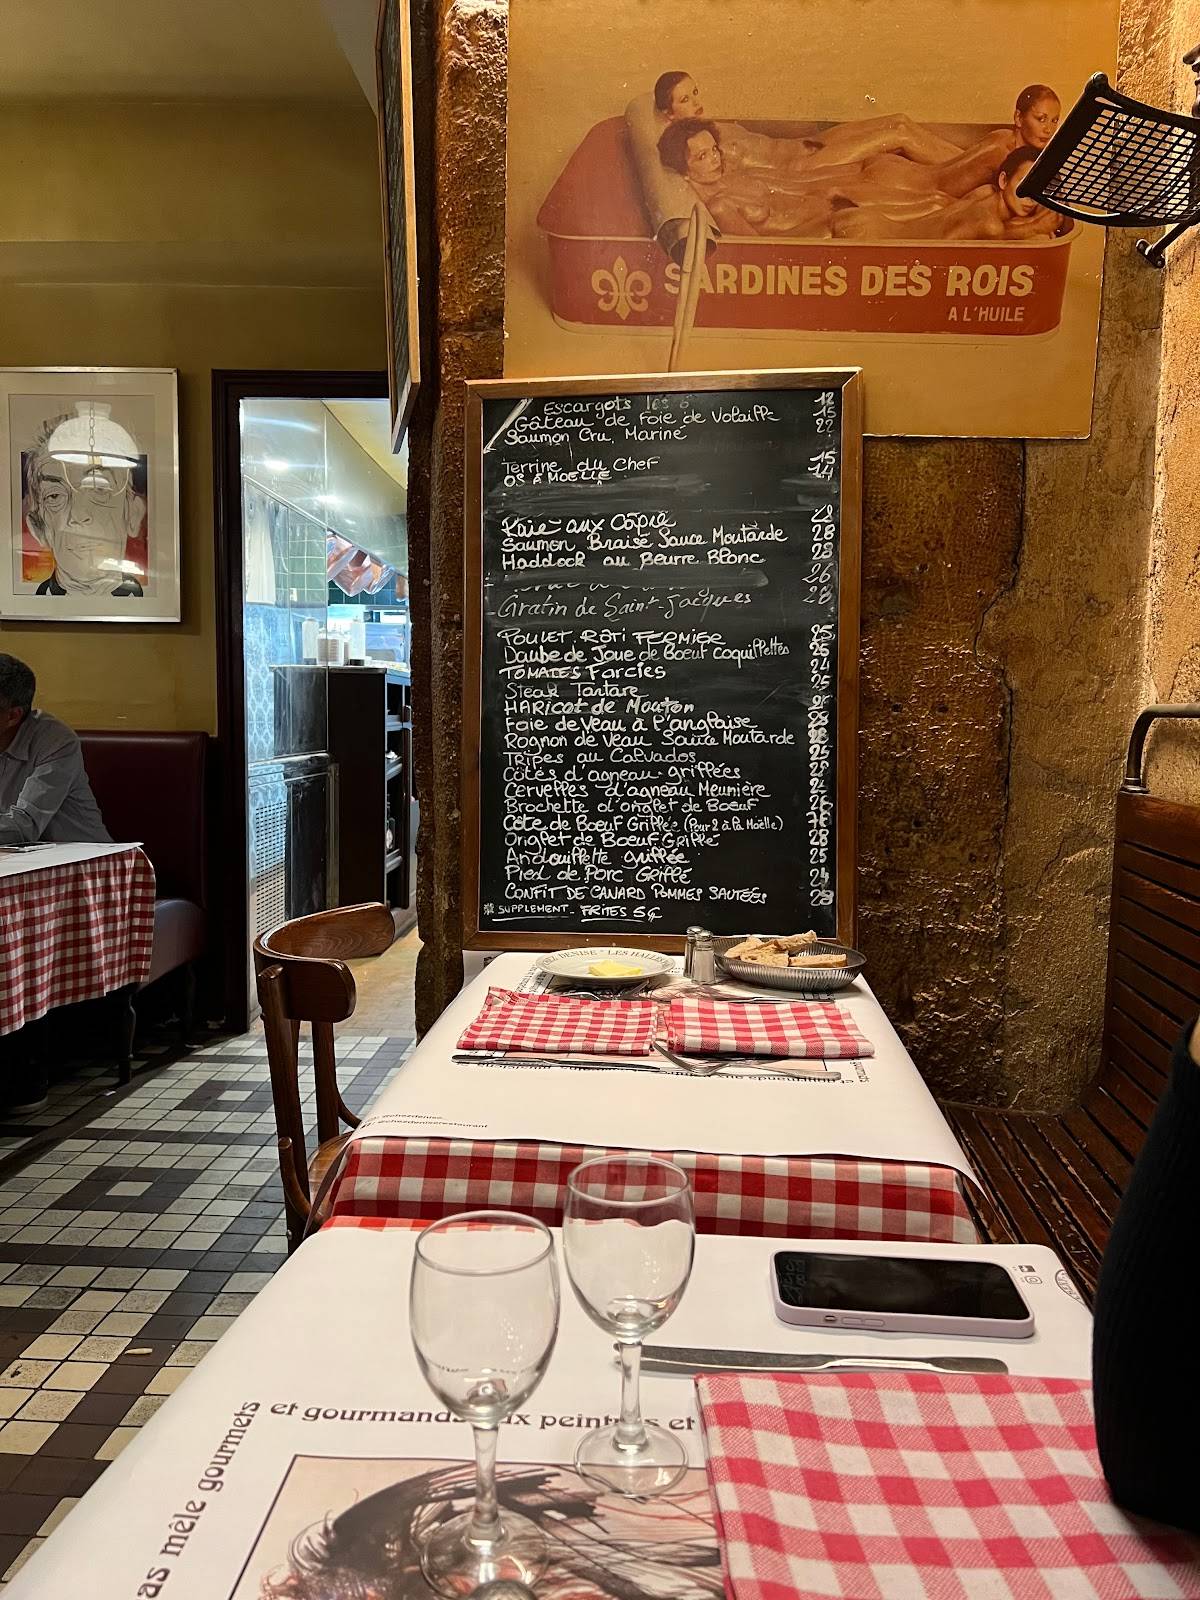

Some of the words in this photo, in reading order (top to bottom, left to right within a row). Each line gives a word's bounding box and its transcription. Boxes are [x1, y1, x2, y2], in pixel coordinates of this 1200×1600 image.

[664, 262, 848, 298] SARDINES
[860, 262, 932, 298] DES
[946, 263, 1036, 298] ROIS
[948, 306, 959, 322] A
[962, 305, 1025, 323] L'HUILE
[543, 395, 632, 420] Escargots
[812, 405, 837, 419] 15
[514, 415, 595, 433] Gâteau
[605, 412, 630, 427] de
[640, 411, 677, 427] Foie
[683, 409, 706, 425] de
[815, 418, 836, 434] 22
[504, 428, 570, 446] Saumon
[625, 425, 688, 442] Mariné
[501, 458, 563, 475] Terrine
[576, 457, 608, 474] du
[810, 450, 838, 466] 15
[503, 473, 526, 488] OS
[564, 518, 606, 535] aux
[811, 523, 836, 542] 28
[500, 537, 576, 553] Saumon
[811, 541, 834, 561] 28
[501, 550, 587, 571] Haddock
[603, 555, 631, 567] au
[497, 593, 569, 618] Gratin
[574, 595, 598, 618] de
[503, 644, 563, 665] Daube
[563, 644, 588, 664] de
[591, 643, 637, 663] Joue
[638, 644, 660, 662] de
[584, 660, 667, 681] Farcies
[810, 657, 830, 675] 24
[569, 679, 650, 698] Tartare
[590, 697, 617, 715] de
[505, 716, 549, 732] Foie
[554, 715, 581, 731] de
[631, 716, 648, 732] à
[503, 732, 568, 756] Rognon
[573, 730, 599, 747] de
[722, 728, 796, 746] Moutarde
[576, 752, 605, 763] au
[503, 796, 590, 814] Brochette
[681, 797, 703, 812] de
[549, 813, 572, 831] de
[711, 817, 720, 832] 2
[721, 818, 732, 831] à
[573, 831, 596, 847] de
[808, 828, 830, 847] 28
[809, 847, 829, 865] 25
[504, 864, 552, 882] Pied
[556, 864, 581, 881] de
[566, 885, 590, 901] DE
[590, 884, 646, 901] CANARD
[269, 1401, 299, 1416] et
[667, 1415, 696, 1431] et
[159, 1499, 207, 1557] mêle
[196, 1400, 261, 1493] gourmets
